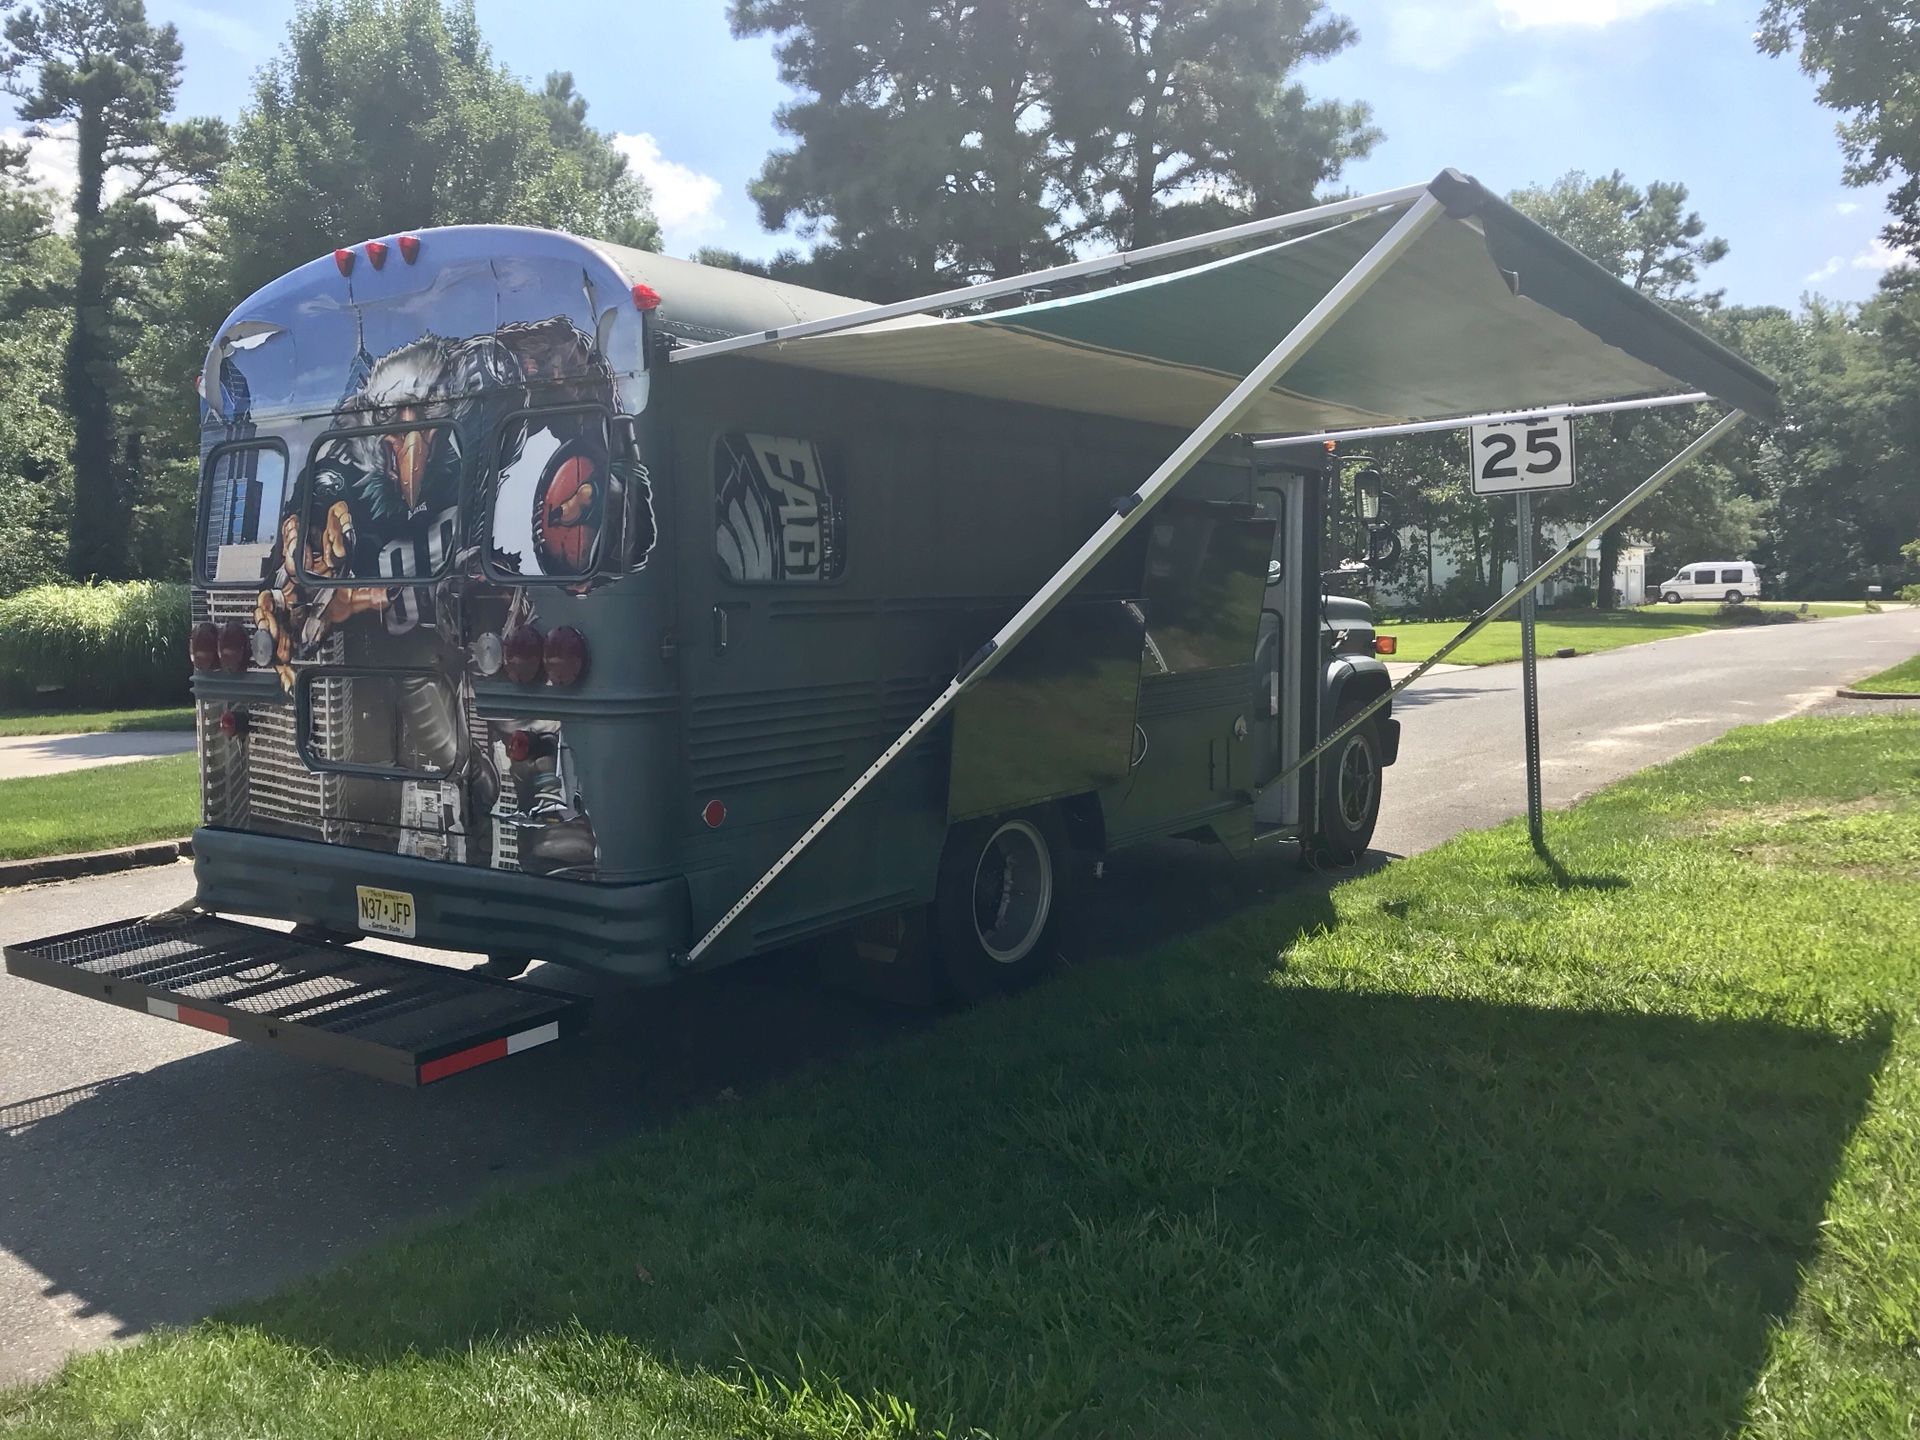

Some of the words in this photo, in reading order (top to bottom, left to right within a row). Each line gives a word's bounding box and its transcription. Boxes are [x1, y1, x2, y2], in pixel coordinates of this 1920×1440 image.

[1480, 427, 1562, 479] 25
[361, 896, 382, 921] N37
[390, 902, 411, 925] JFP
[371, 921, 388, 930] Garden
